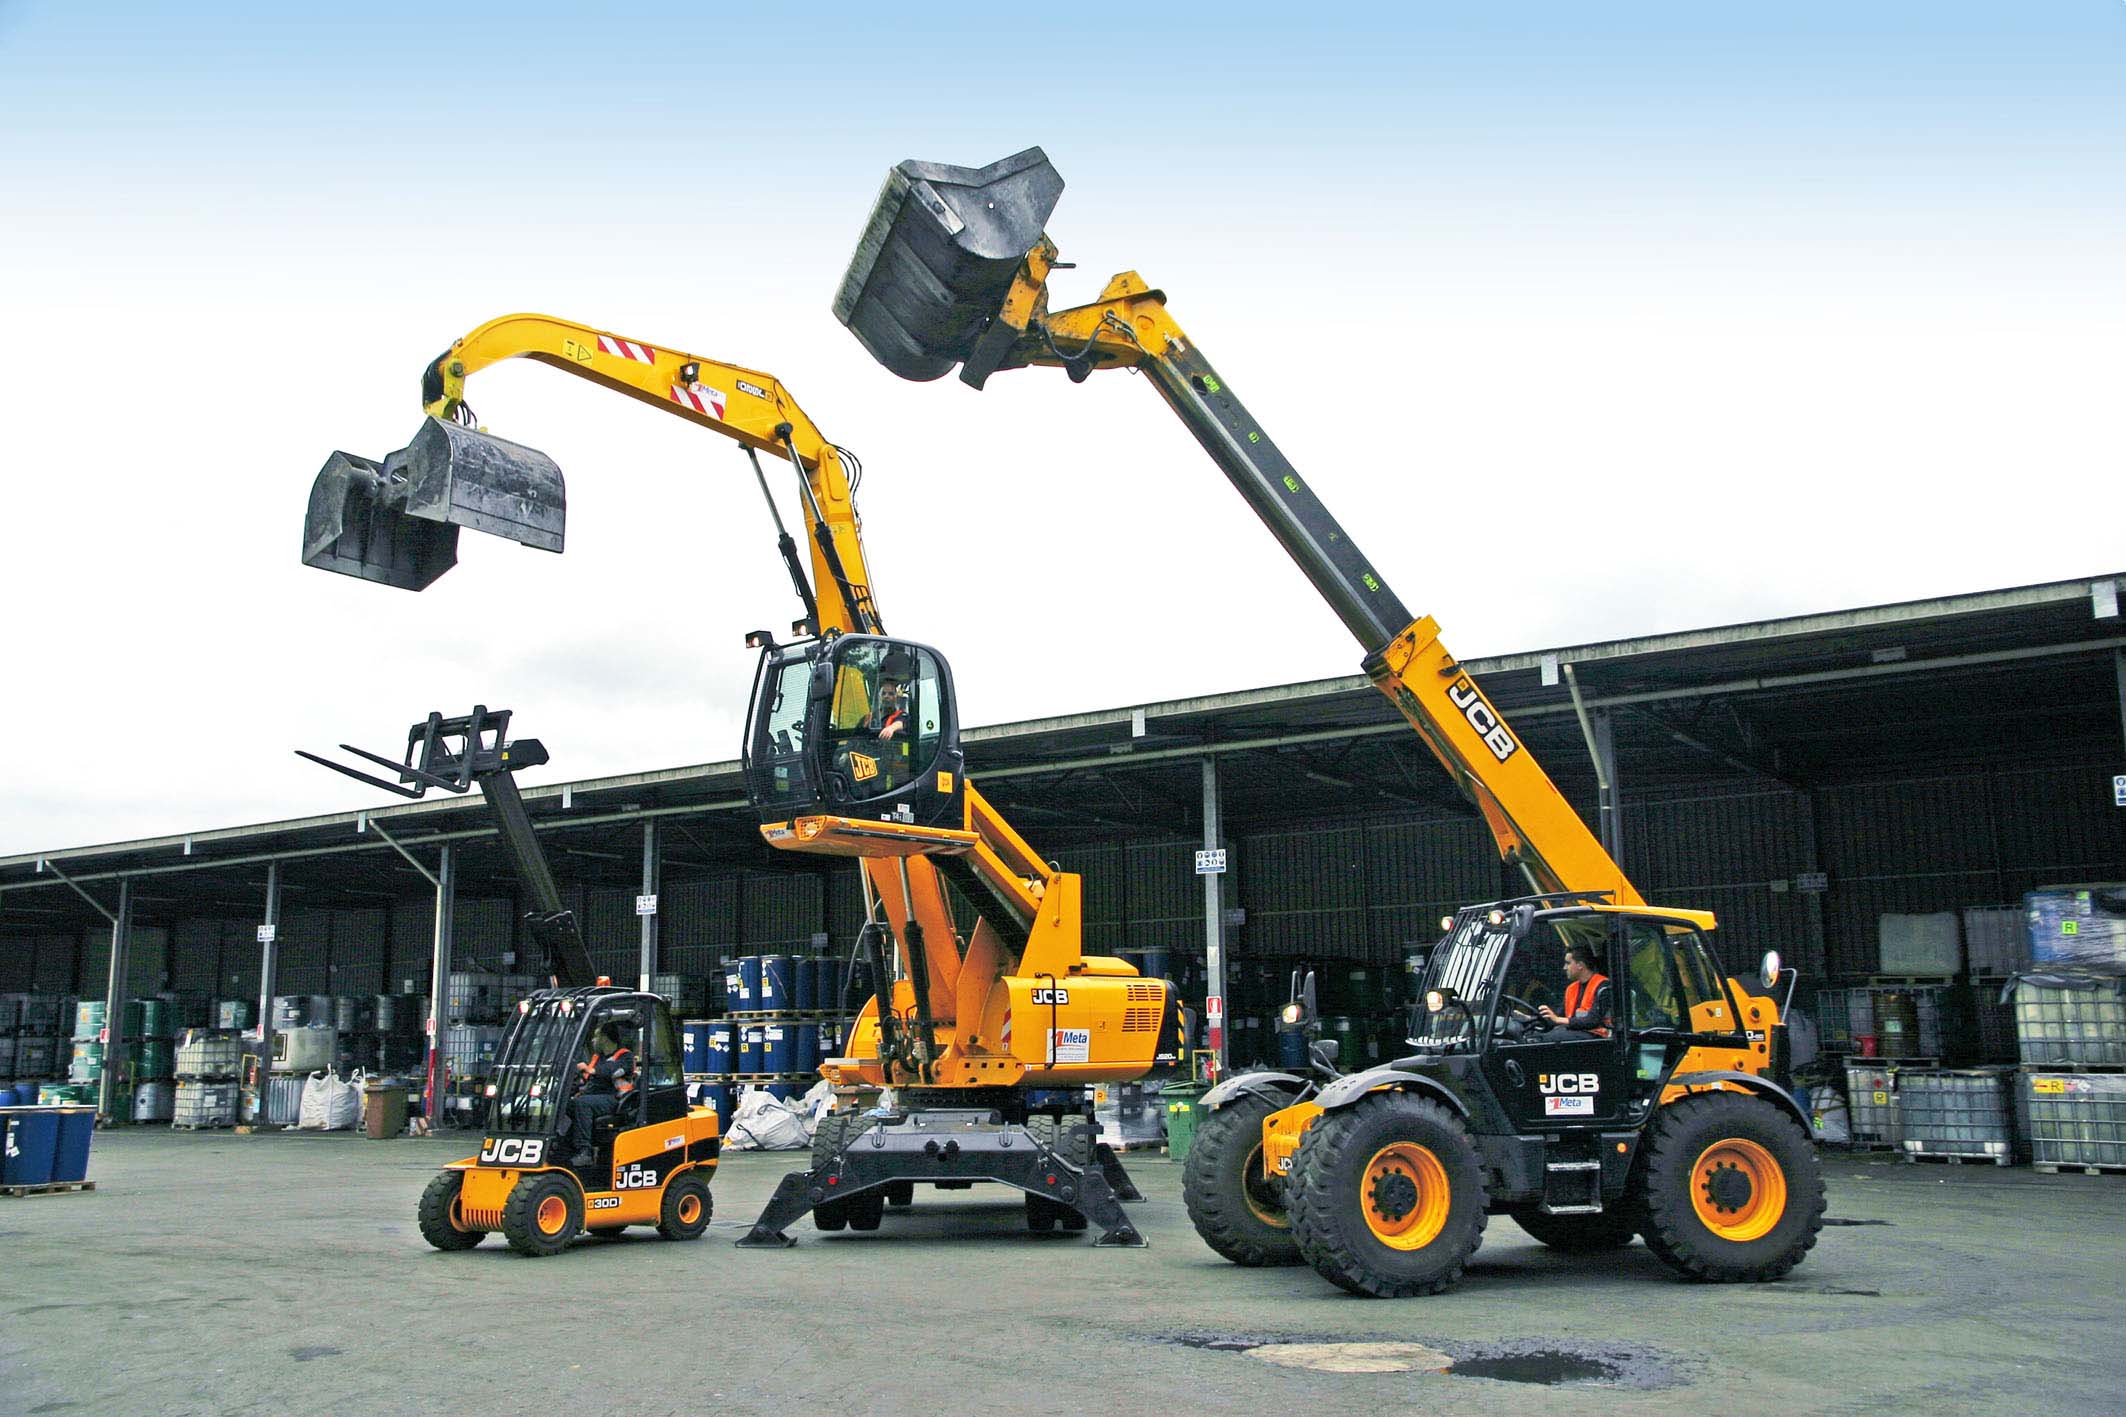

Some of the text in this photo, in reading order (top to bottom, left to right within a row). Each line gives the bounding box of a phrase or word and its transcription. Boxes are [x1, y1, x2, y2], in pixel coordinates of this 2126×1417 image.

[1449, 685, 1515, 760] JCB
[854, 755, 877, 779] JCB
[2065, 923, 2073, 932] R
[1032, 989, 1069, 1004] JCB
[1539, 1073, 1600, 1094] JCB
[2050, 1080, 2061, 1091] R
[480, 1137, 544, 1164] JCB
[1278, 1156, 1293, 1170] JC
[615, 1169, 657, 1189] JCB
[594, 1197, 618, 1209] 30D
